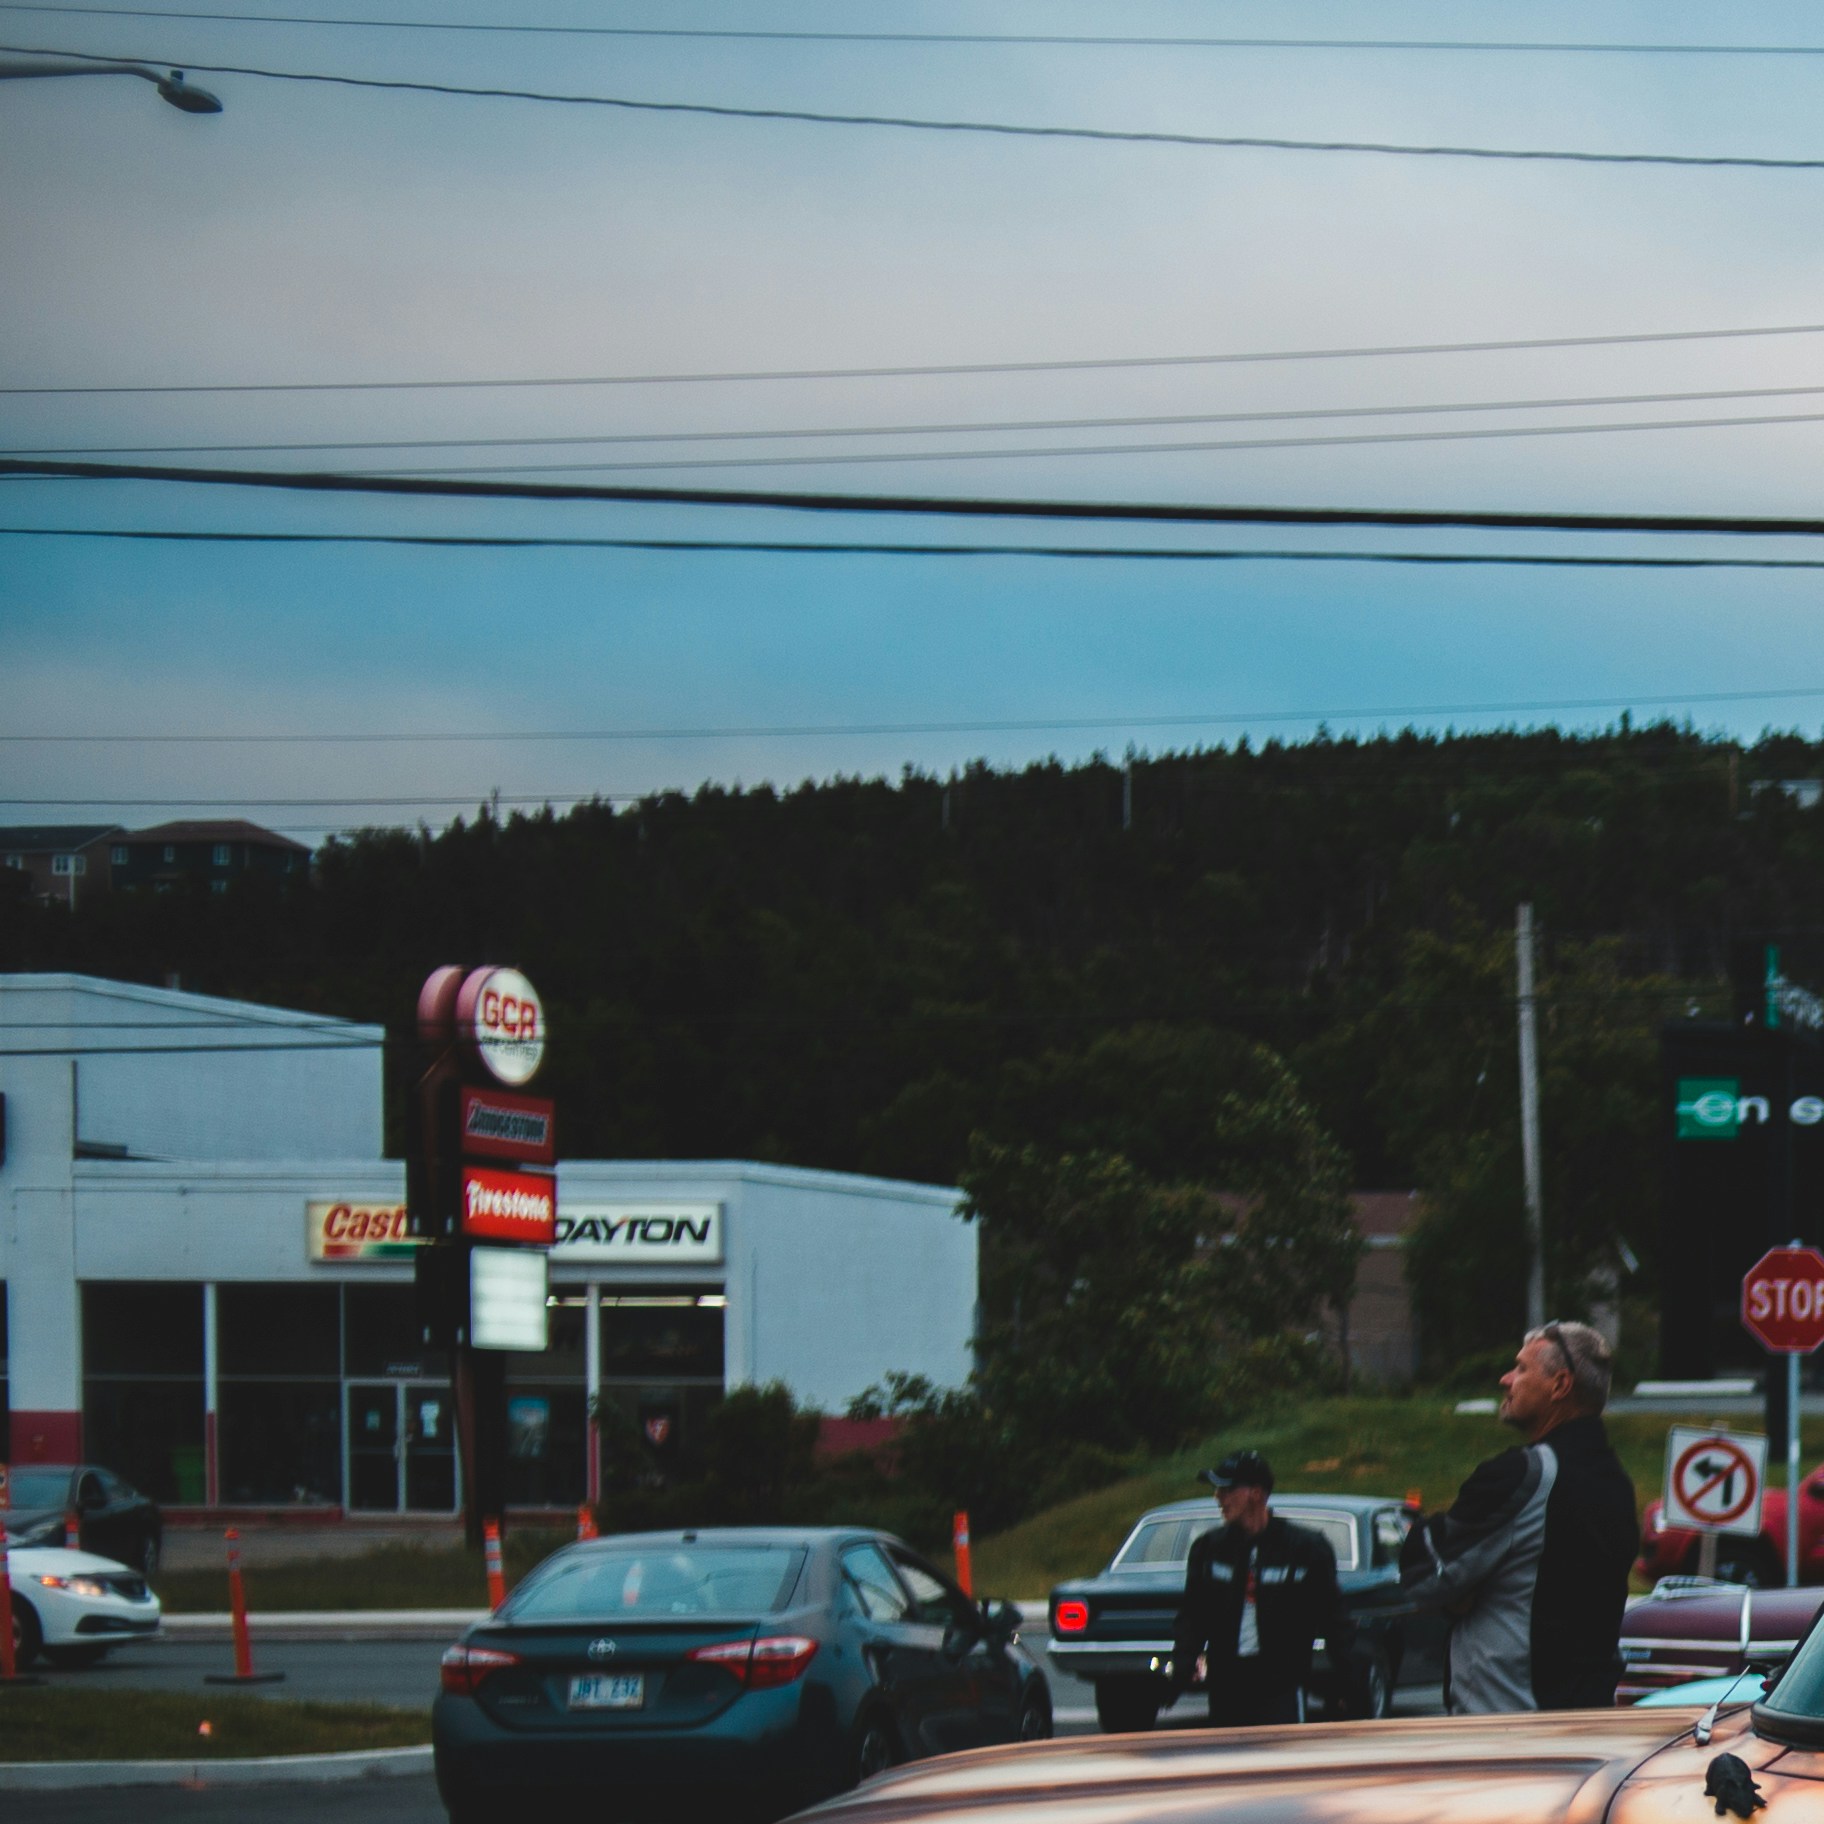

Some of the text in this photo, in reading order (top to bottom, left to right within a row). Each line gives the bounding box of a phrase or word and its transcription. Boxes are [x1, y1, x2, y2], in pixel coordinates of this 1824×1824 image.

[483, 990, 536, 1040] GCR
[466, 1178, 551, 1222] Firestone
[554, 1214, 712, 1246] DAYTON
